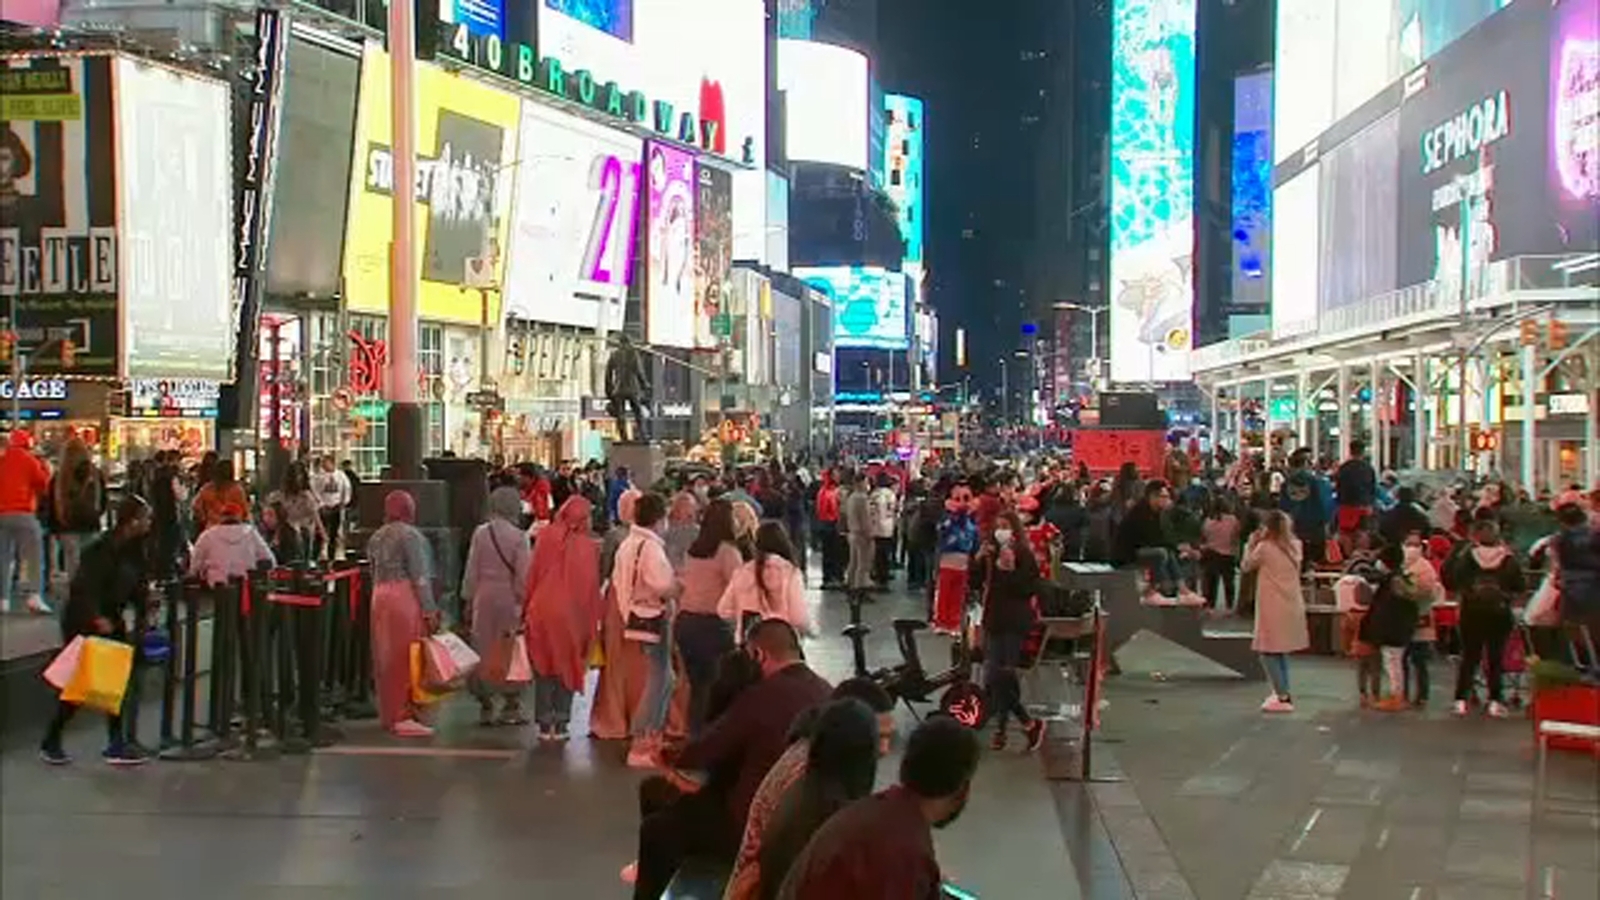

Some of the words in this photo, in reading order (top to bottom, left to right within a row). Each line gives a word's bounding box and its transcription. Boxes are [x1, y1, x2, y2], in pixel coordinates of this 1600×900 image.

[518, 43, 719, 150] BROADWAY
[1423, 89, 1509, 175] SEPHORA
[579, 154, 641, 287] 21
